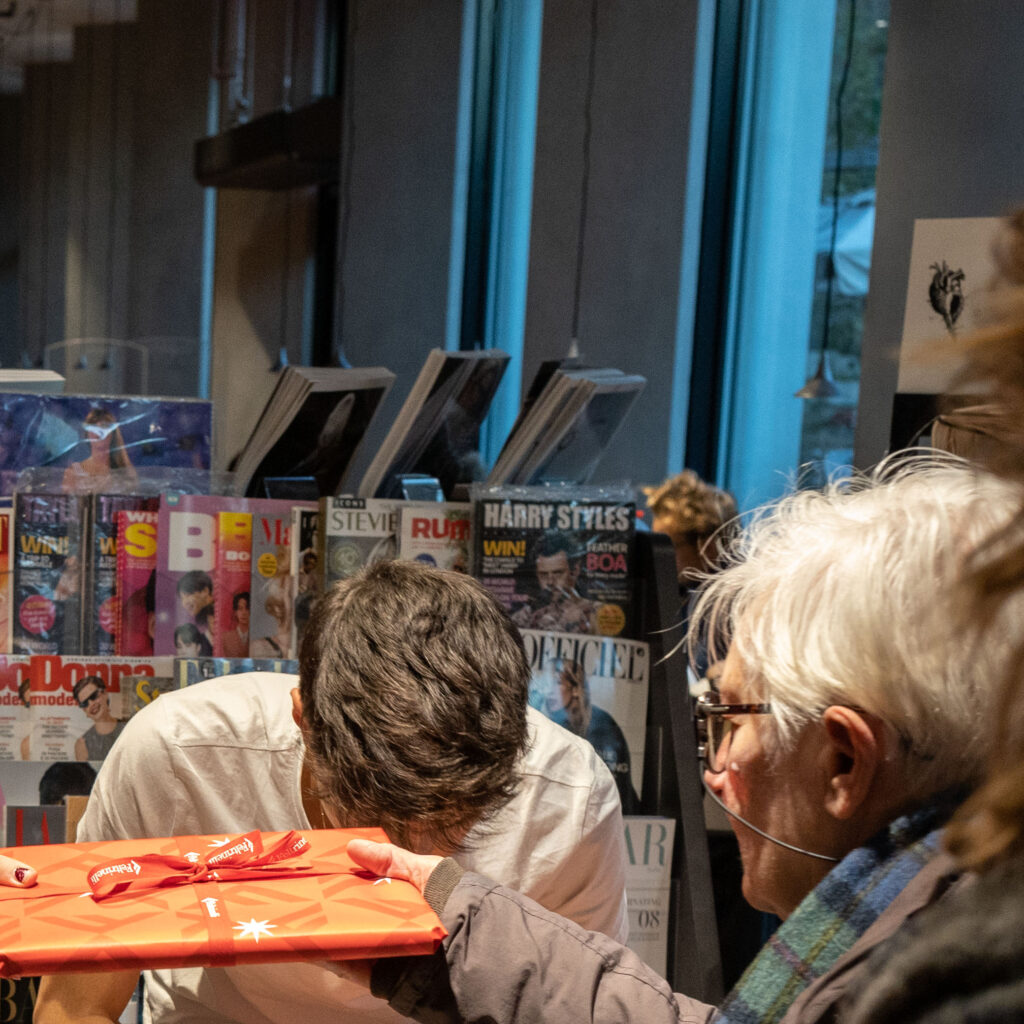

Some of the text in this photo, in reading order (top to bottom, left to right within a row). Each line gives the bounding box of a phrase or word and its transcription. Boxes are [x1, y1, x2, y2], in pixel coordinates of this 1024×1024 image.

[332, 511, 396, 532] STEVIE
[484, 502, 631, 531] HARRY STYLES
[483, 540, 526, 557] WIN!
[587, 553, 627, 572] BOA
[30, 655, 156, 693] Donna
[208, 840, 249, 865] Feltrinelli
[90, 862, 134, 886] Feltrinelli
